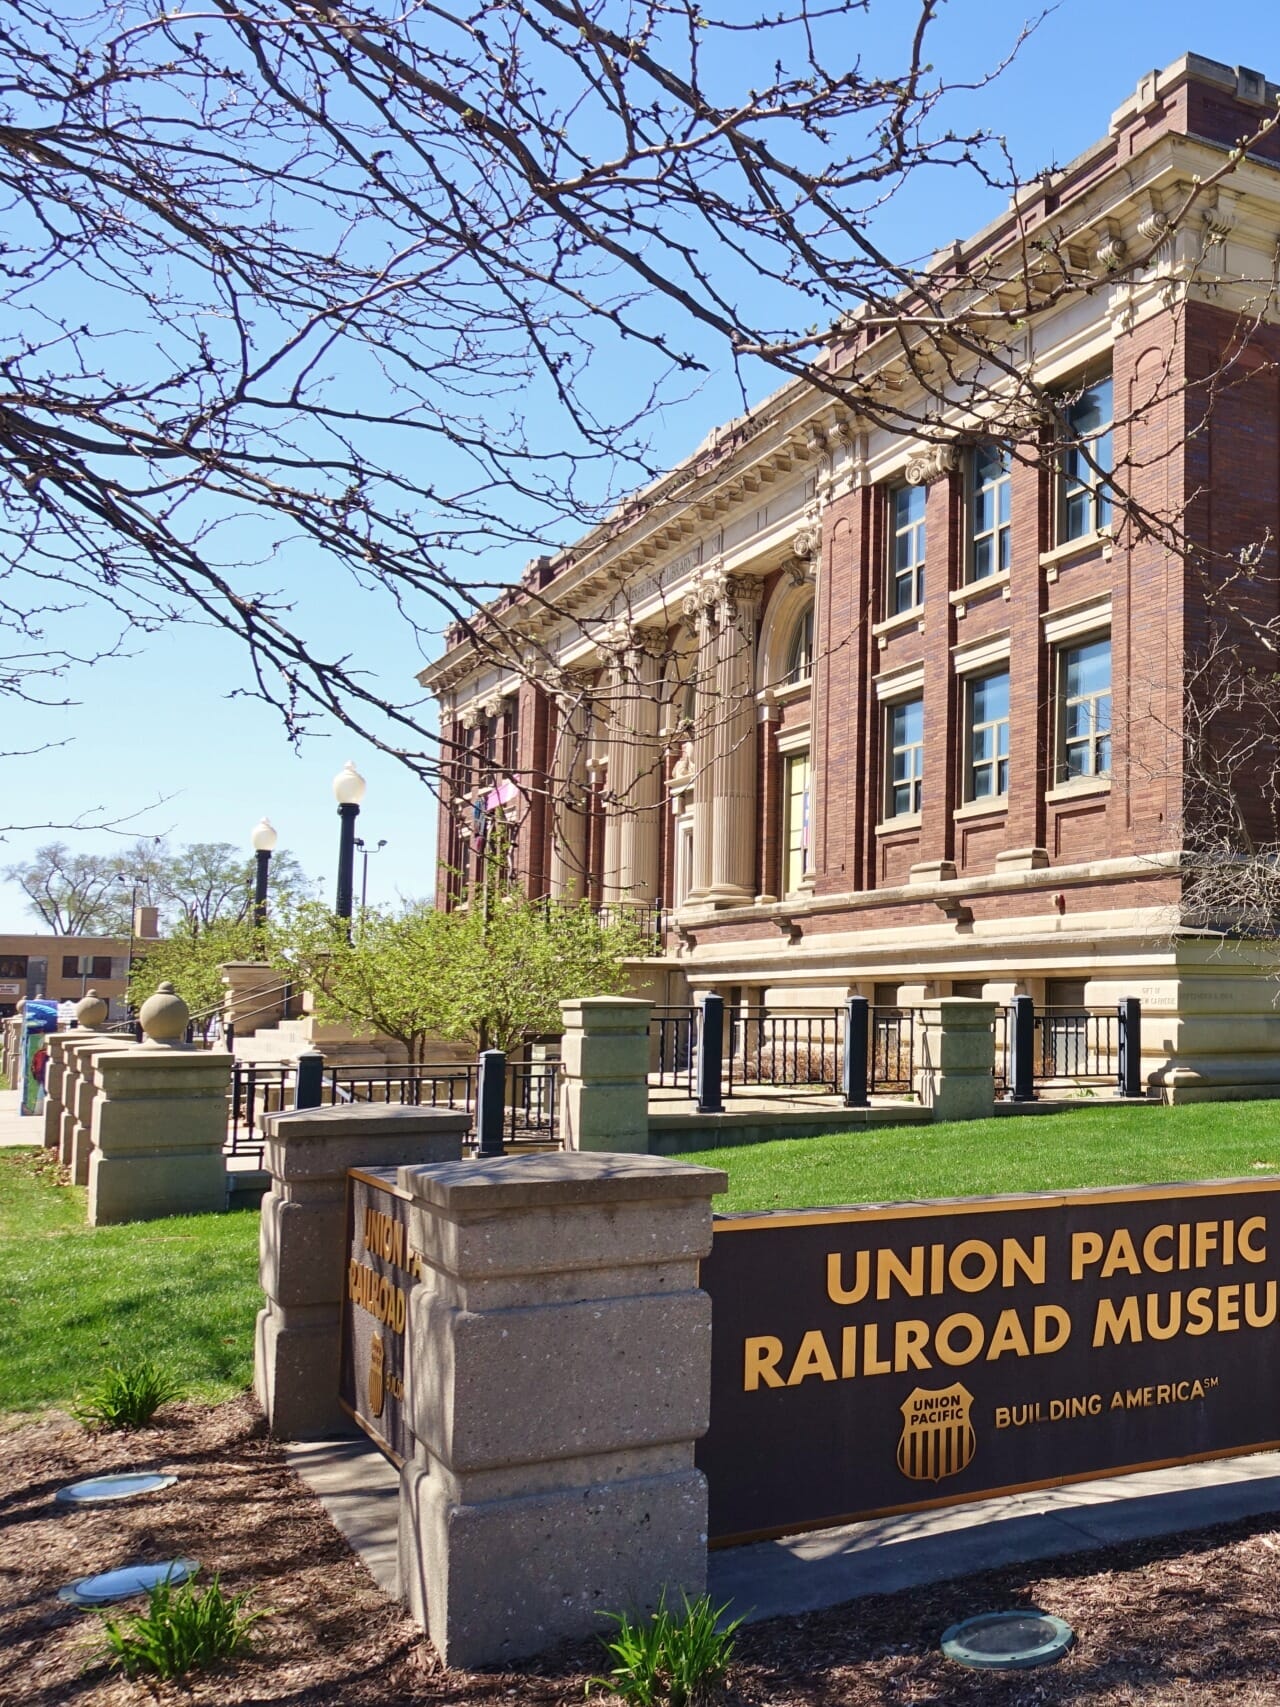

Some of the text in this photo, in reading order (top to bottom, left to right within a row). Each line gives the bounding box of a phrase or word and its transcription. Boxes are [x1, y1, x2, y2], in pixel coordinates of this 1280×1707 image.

[363, 1206, 403, 1268] UNION
[826, 1215, 1267, 1306] UNION PACIFIC
[348, 1257, 406, 1335] RAILROAD
[743, 1303, 1073, 1391] RAILROAD
[910, 1408, 964, 1426] PACIFIC
[913, 1395, 961, 1411] UNION
[995, 1394, 1102, 1429] BUILDING
